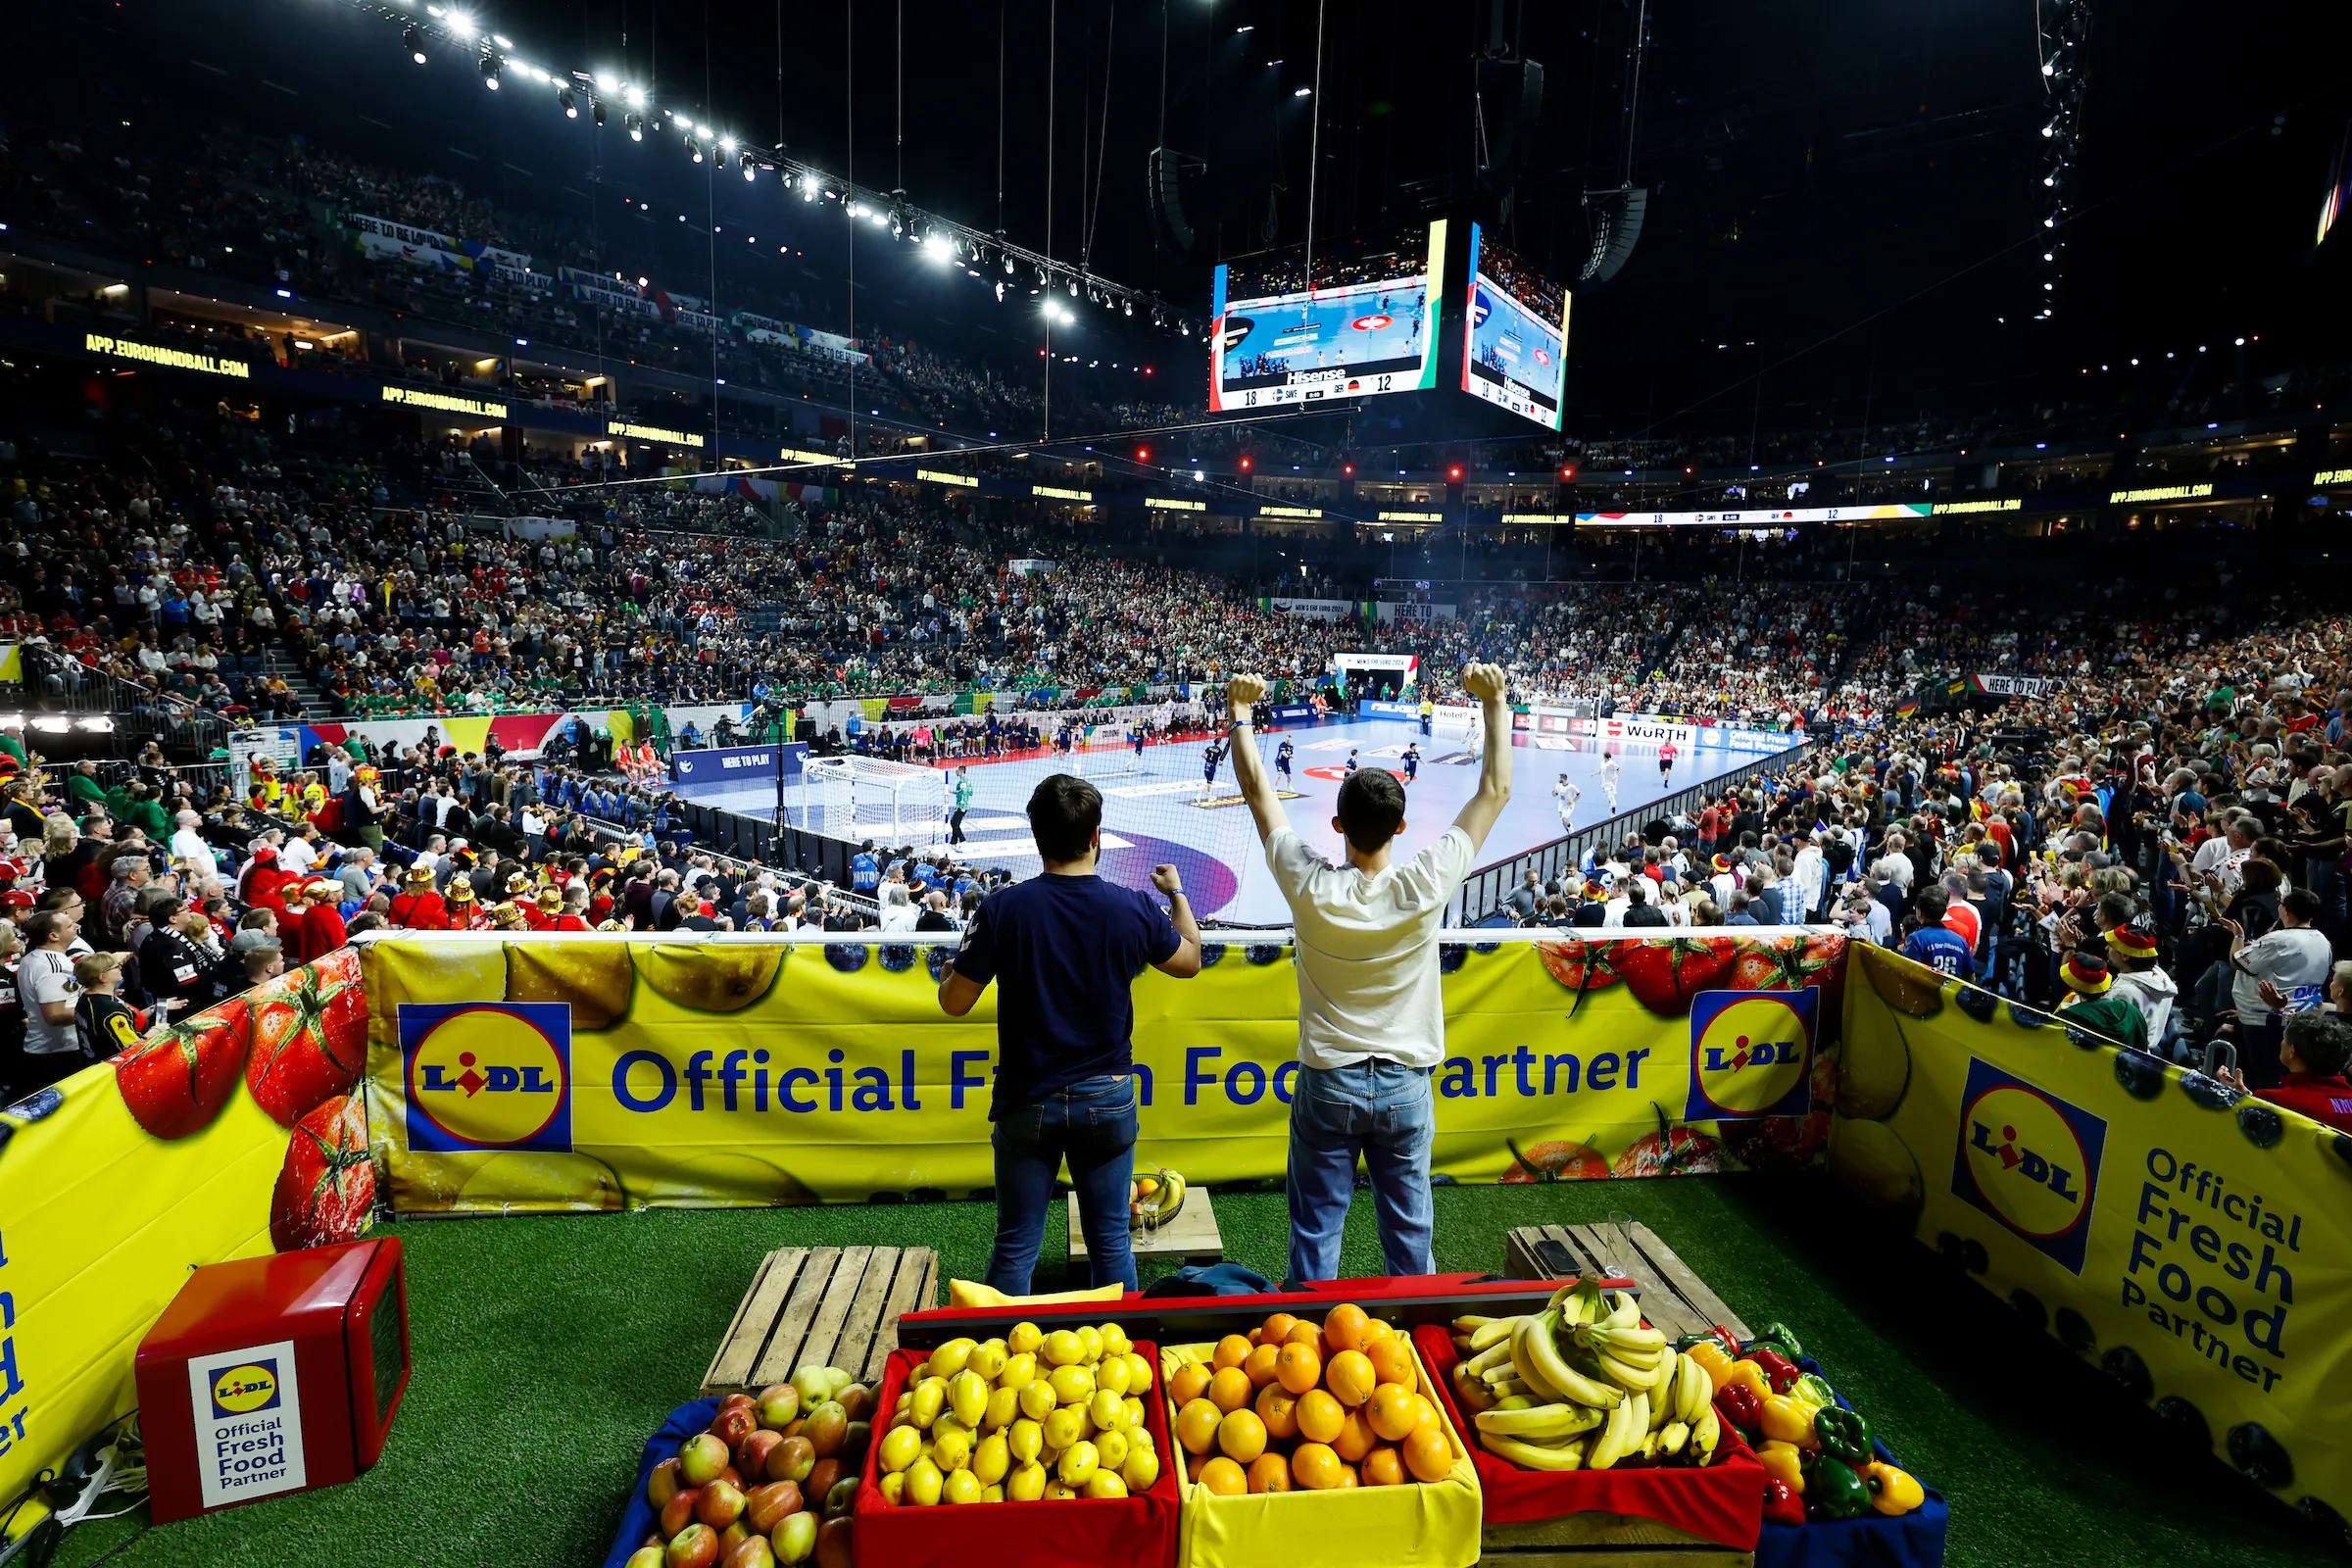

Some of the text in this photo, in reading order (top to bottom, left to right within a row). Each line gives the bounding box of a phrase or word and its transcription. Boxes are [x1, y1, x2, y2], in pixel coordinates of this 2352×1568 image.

[85, 334, 249, 378] APP.EUROHANDBALL.COM
[1287, 368, 1347, 385] Hisense
[382, 386, 507, 418] APP.EUROHANDBALL.COM
[1245, 391, 1256, 406] 18
[1377, 374, 1392, 391] 12
[608, 421, 704, 447] APP.EUROHANDBALL.COM
[2110, 484, 2213, 504] APP.EUROHANDBALL.COM
[1652, 514, 1663, 523] 18
[1827, 509, 1838, 520] 12
[1420, 606, 1432, 617] TO
[1988, 677, 2011, 692] HERE
[2013, 680, 2026, 694] TO
[1440, 710, 1468, 719] Hotel?
[1729, 740, 1754, 751] Food
[1763, 733, 1790, 745] Fresh
[721, 754, 770, 769] HERE TO PLAY
[612, 1048, 921, 1113] Official
[1184, 1046, 1299, 1105] Foo
[1431, 1044, 1650, 1100] artner
[2146, 1148, 2302, 1252] Official
[2137, 1182, 2294, 1304] Fresh
[2128, 1229, 2287, 1359] Food
[2122, 1276, 2282, 1394] Partner
[215, 1417, 282, 1441] Official
[216, 1433, 284, 1458] Fresh
[218, 1447, 286, 1477] Food
[219, 1467, 287, 1490] Partner
